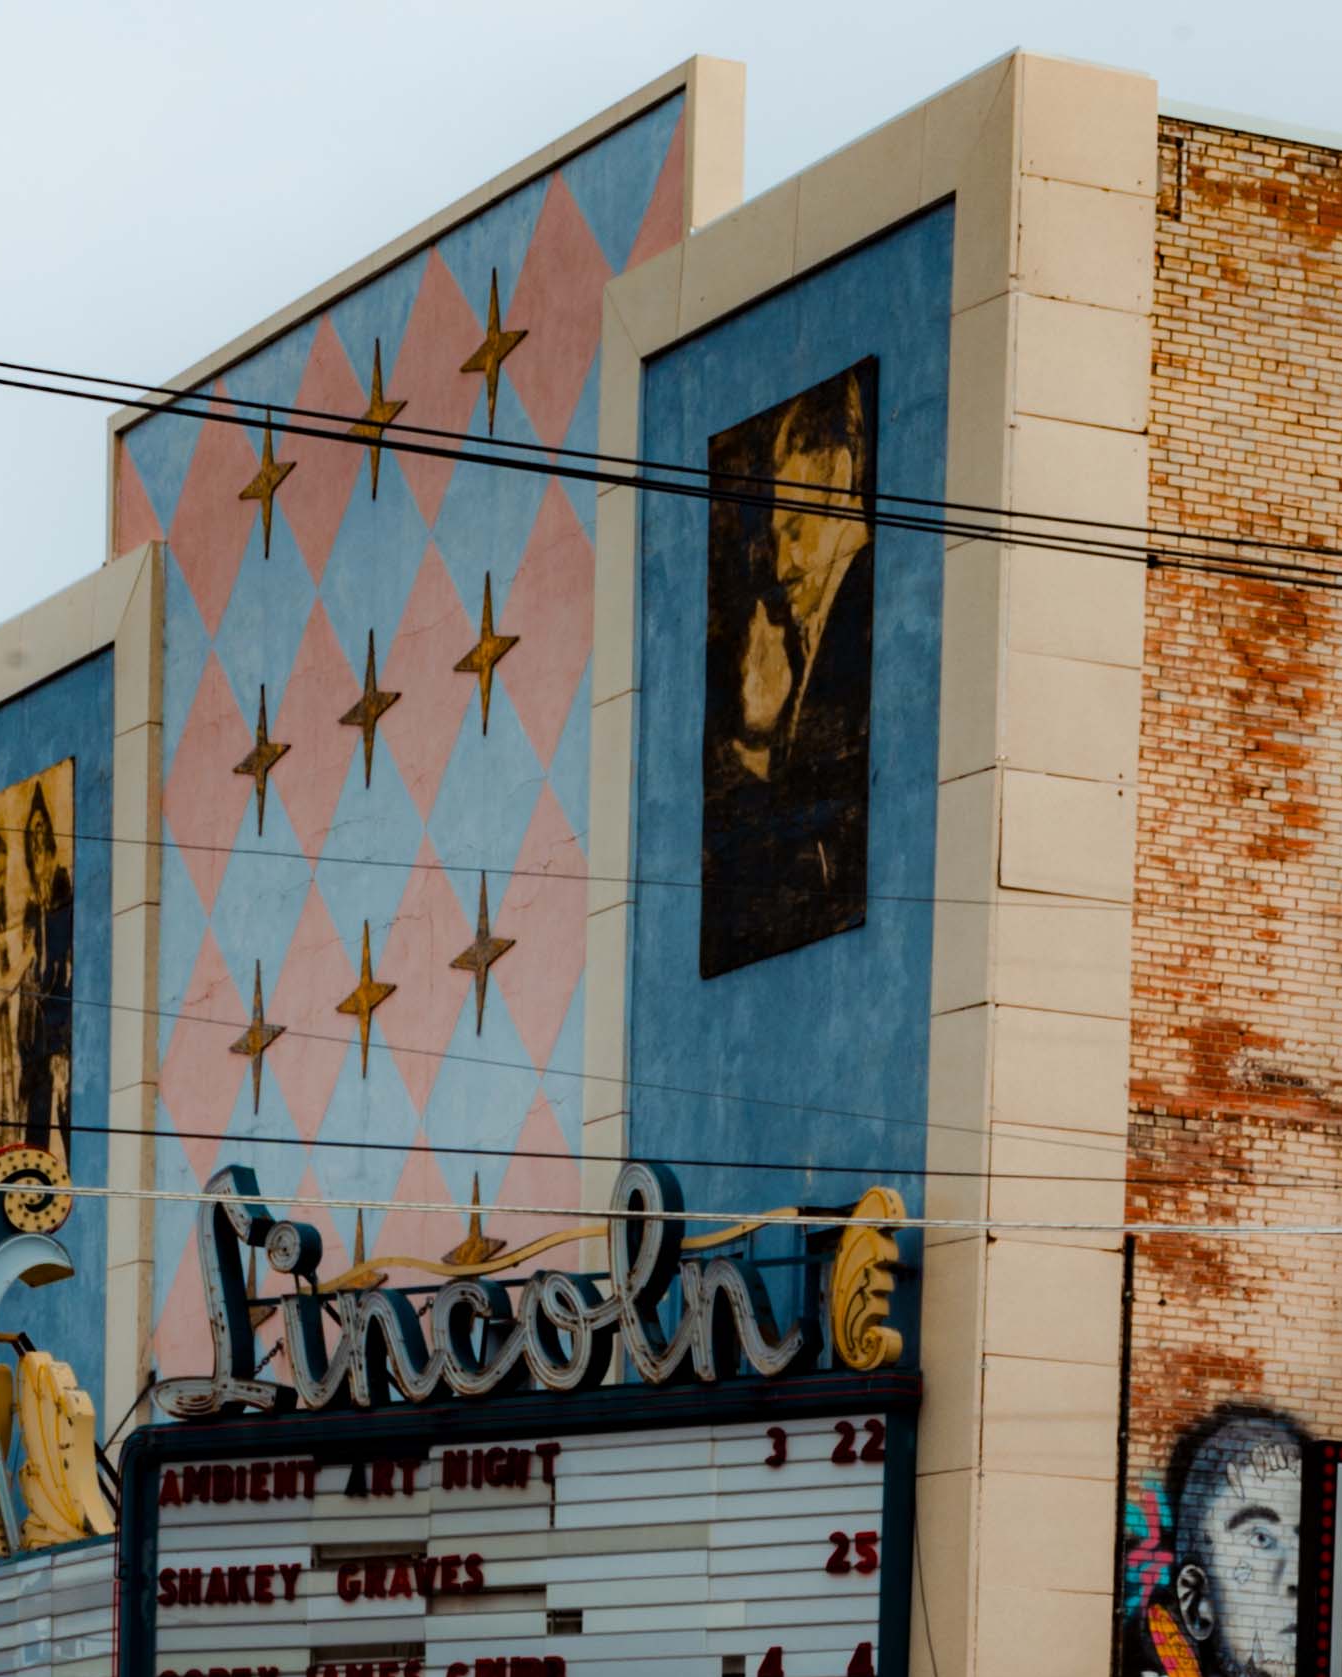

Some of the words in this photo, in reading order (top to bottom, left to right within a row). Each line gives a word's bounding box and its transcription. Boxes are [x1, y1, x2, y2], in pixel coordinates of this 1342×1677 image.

[151, 1160, 817, 1421] Lincoln
[159, 1460, 321, 1506] AMBIENT
[345, 1457, 420, 1497] ART
[442, 1443, 560, 1490] NIGHT
[765, 1427, 786, 1466] 3
[832, 1419, 885, 1463] 22
[158, 1563, 302, 1607] SHAKEY
[338, 1553, 484, 1601] GRAVES
[826, 1531, 878, 1574] 25
